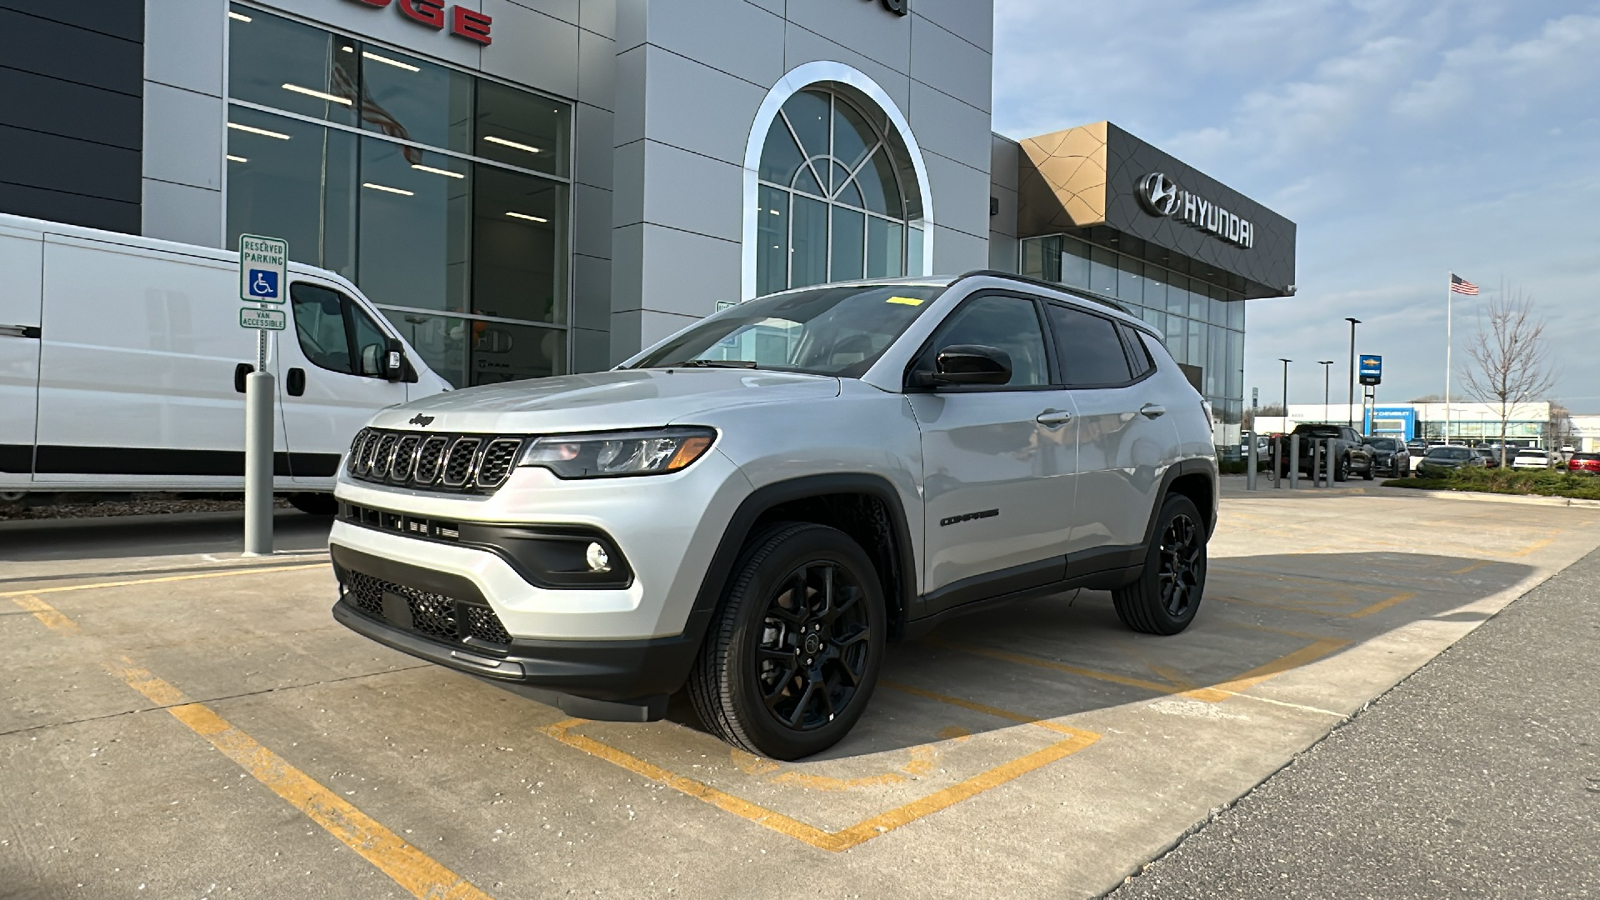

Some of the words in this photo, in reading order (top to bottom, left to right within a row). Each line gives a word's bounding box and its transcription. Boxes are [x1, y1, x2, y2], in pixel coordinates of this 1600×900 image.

[355, 0, 492, 46] GE
[1184, 190, 1253, 249] HYUNDAI
[244, 241, 283, 254] RESERVED
[244, 253, 283, 265] PARKING
[257, 311, 270, 319] VAN
[243, 318, 283, 328] ACCESSIBLE
[409, 413, 435, 427] Jeep
[940, 508, 999, 527] COMPASS
